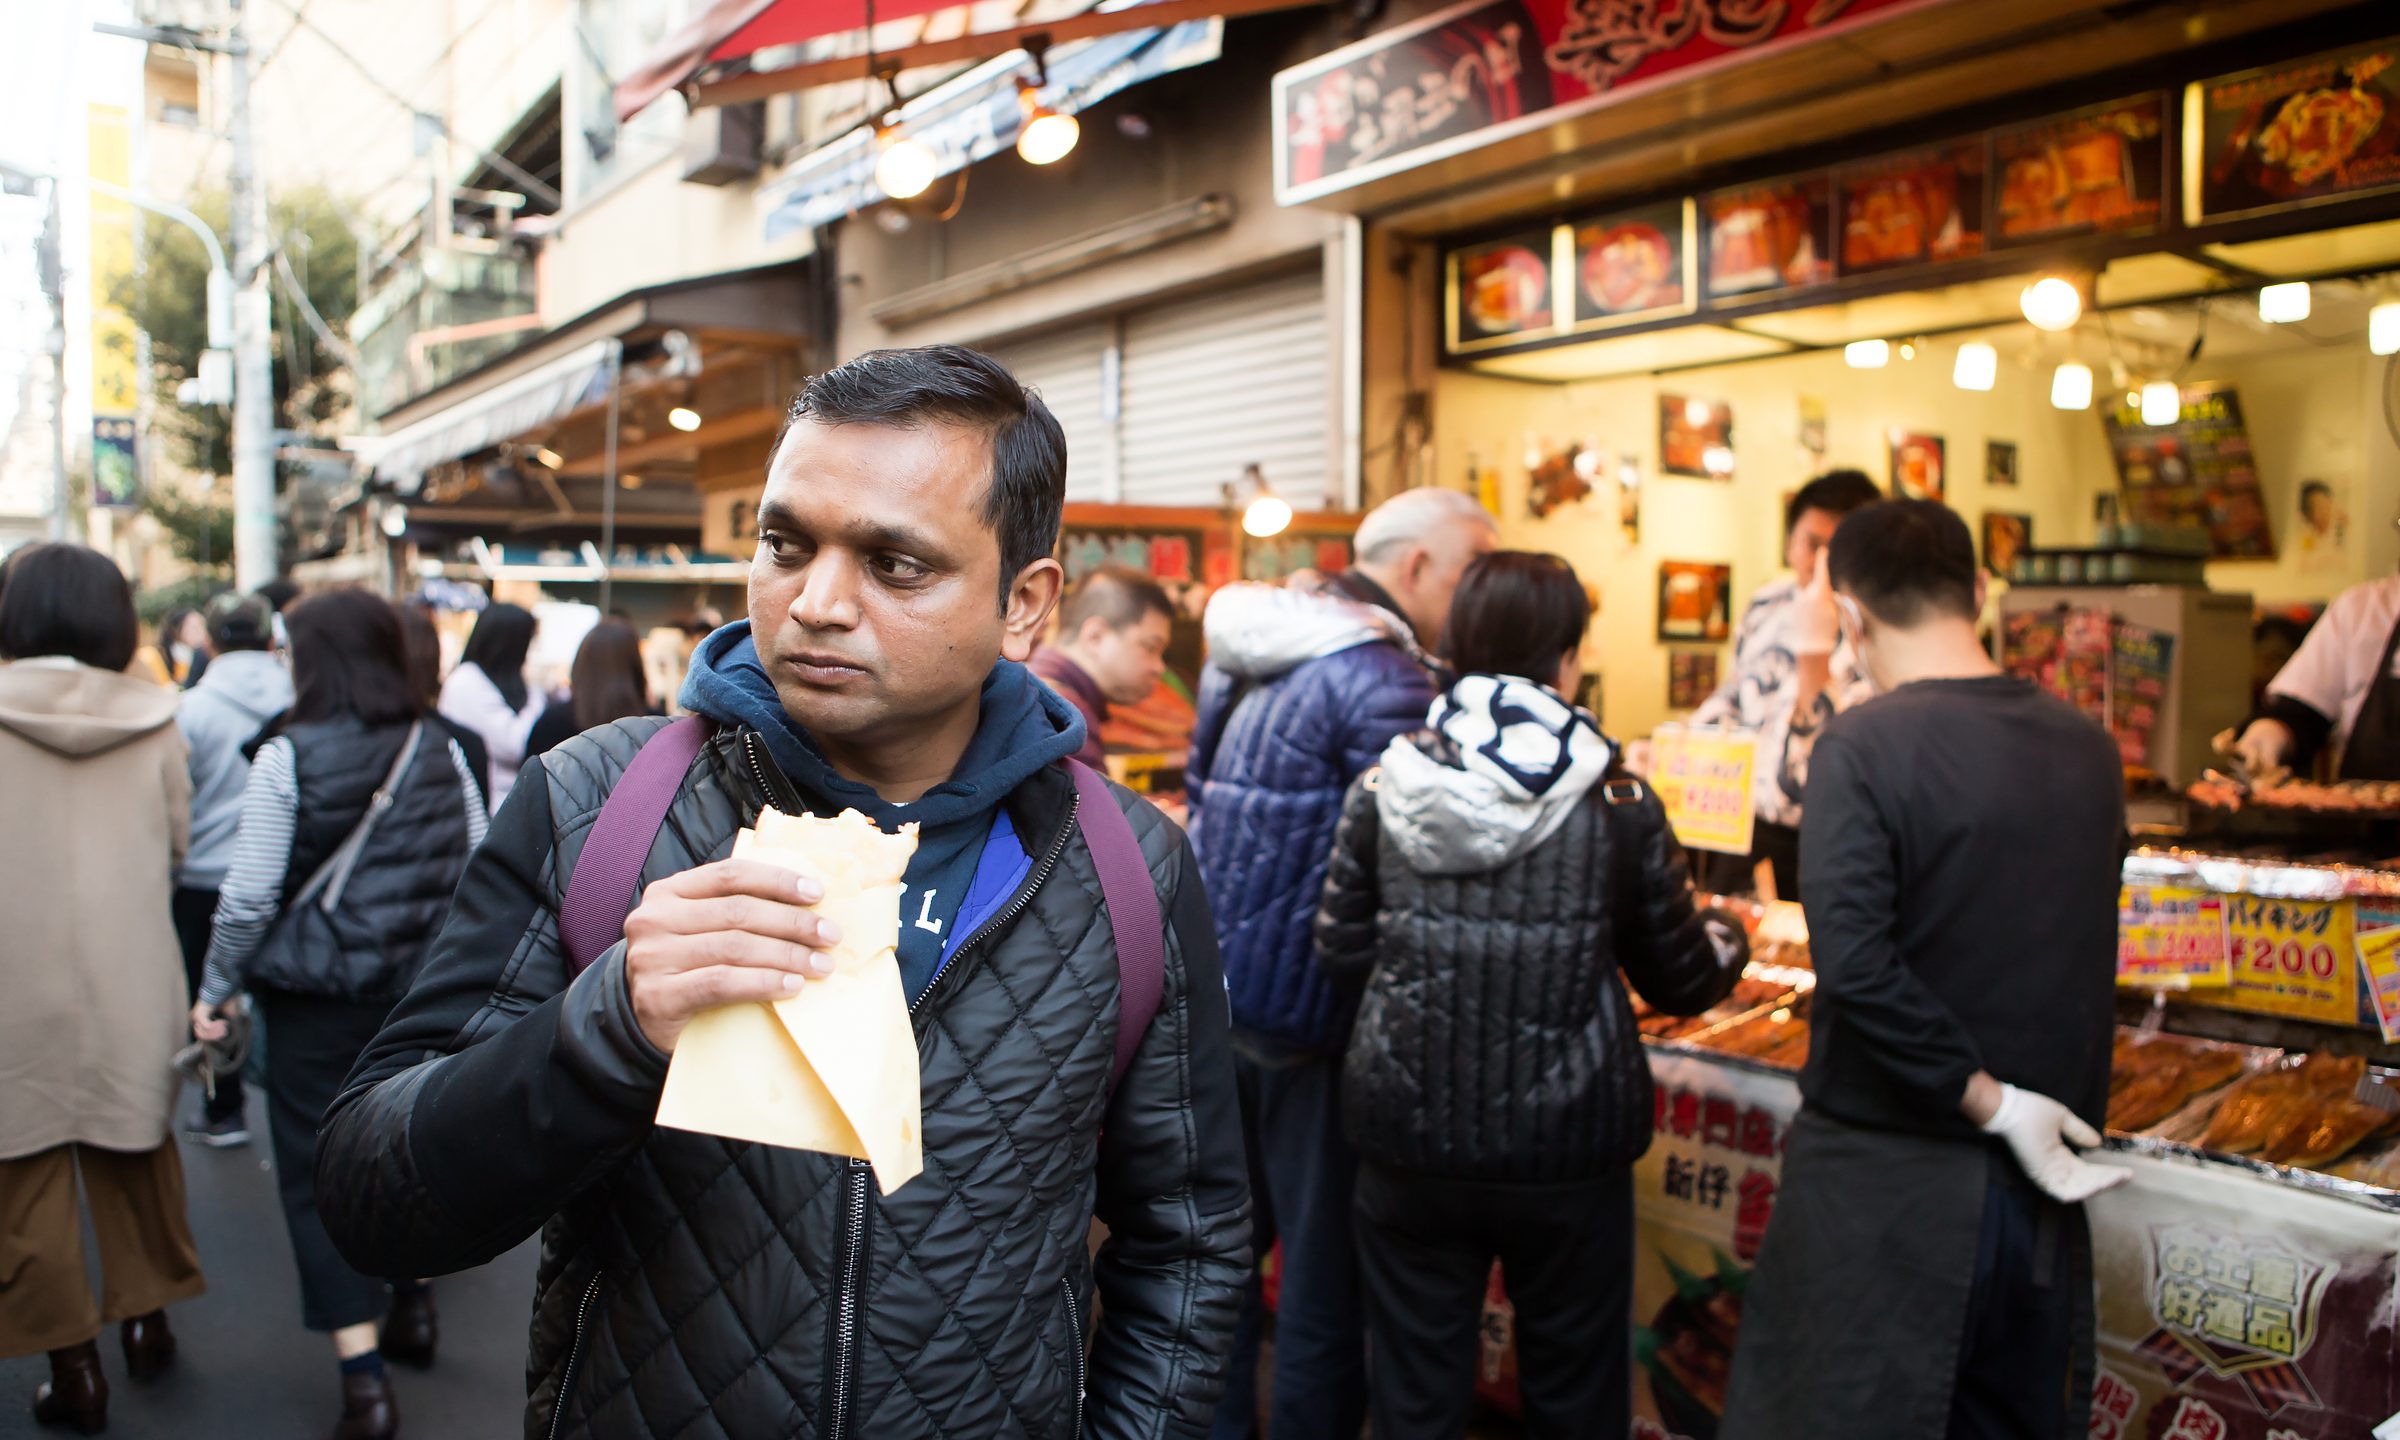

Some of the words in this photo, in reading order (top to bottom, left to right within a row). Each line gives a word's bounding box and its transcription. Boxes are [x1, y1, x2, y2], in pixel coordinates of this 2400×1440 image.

[2228, 897, 2333, 936] バイキング
[2231, 937, 2336, 980] ¥200
